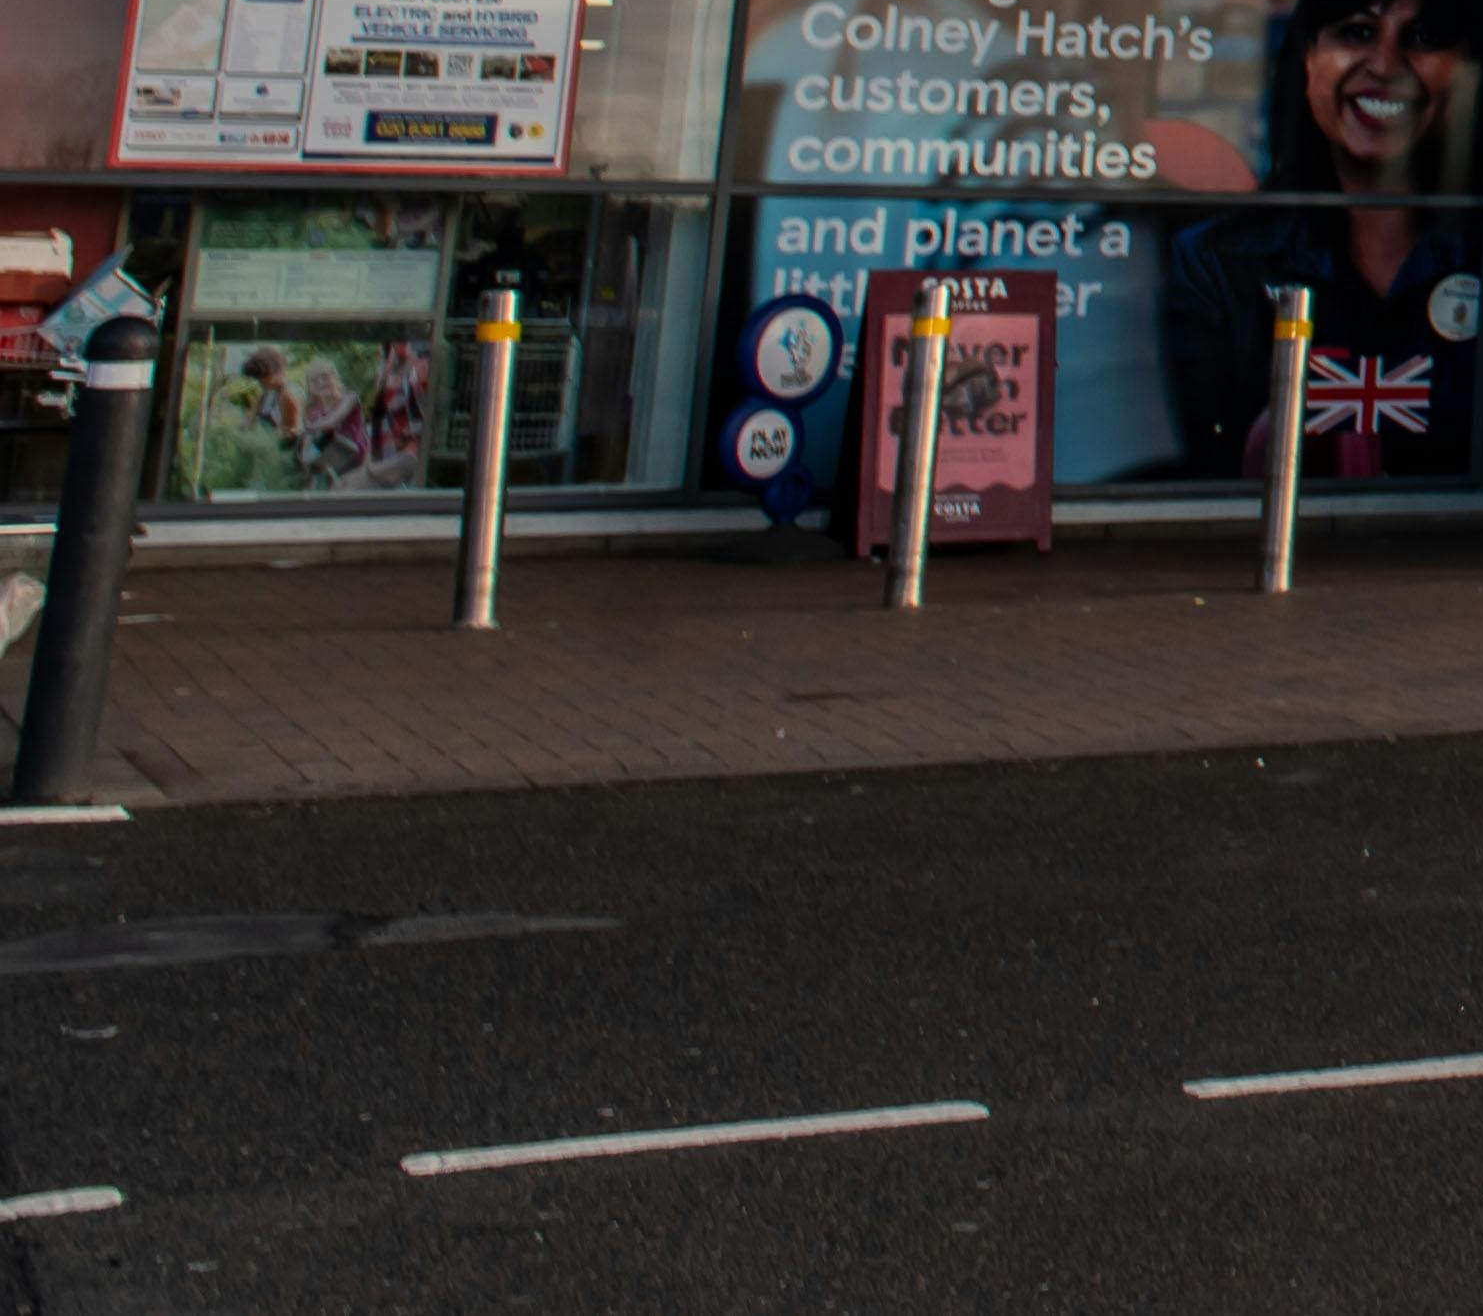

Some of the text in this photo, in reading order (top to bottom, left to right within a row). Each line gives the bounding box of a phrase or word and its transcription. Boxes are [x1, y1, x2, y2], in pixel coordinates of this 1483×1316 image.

[354, 3, 539, 25] ELECTRIC and HYBRID
[360, 21, 528, 40] VEHICLE SERVICING
[801, 2, 1000, 66] Colney
[794, 70, 1111, 126] customers,
[788, 130, 1158, 179] communities
[776, 207, 1131, 267] and planet a
[773, 268, 869, 317] littl
[751, 426, 789, 444] PLAY
